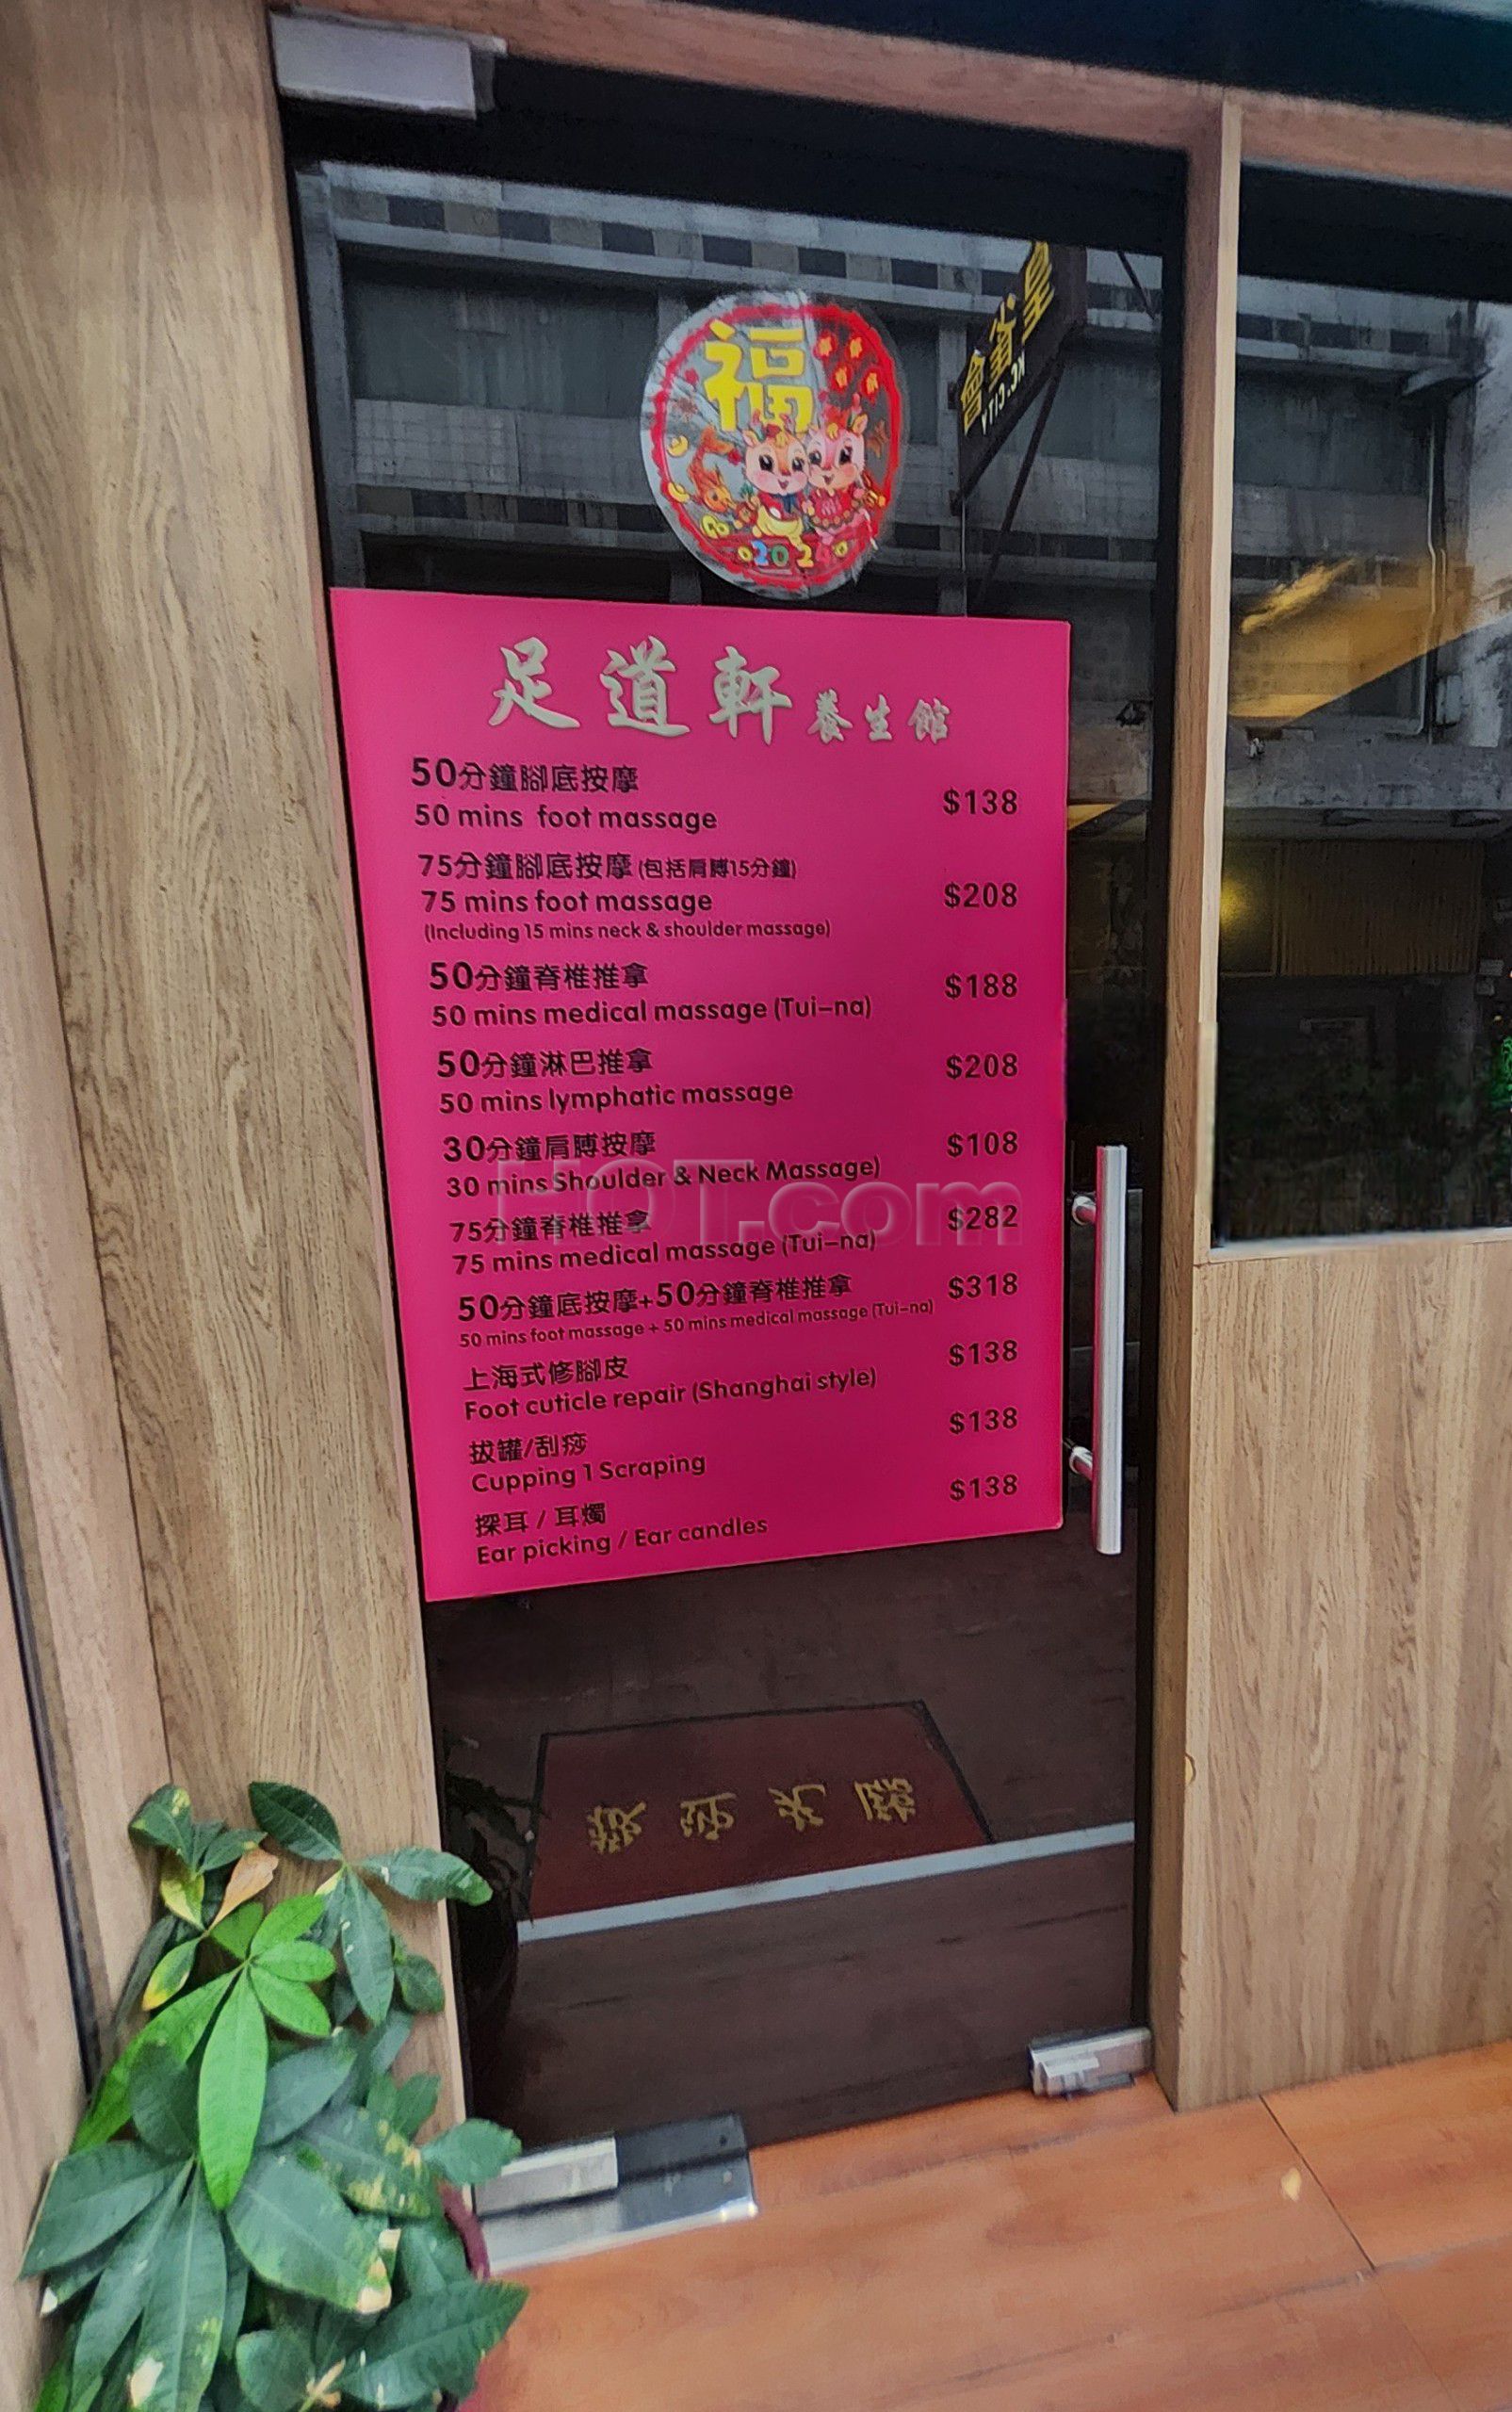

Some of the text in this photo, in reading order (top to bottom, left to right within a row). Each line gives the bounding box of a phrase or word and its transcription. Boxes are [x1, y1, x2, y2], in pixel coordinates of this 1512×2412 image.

[703, 318, 814, 433] 福
[489, 636, 951, 745] 足道軒 養生館
[412, 757, 639, 792] 50分鐘腳底按摩
[943, 790, 1017, 815] $138
[415, 804, 717, 834] 50 mins foot massage
[418, 852, 632, 880] 75分鐘腳底按摩
[422, 890, 712, 916] 75 mins foot massage
[944, 881, 1017, 908] $208
[425, 920, 831, 942] (Including 15 mins neck & shoulder massage)
[429, 961, 649, 992] 50分鐘脊椎推拿
[945, 973, 1017, 1000] $188
[431, 1005, 465, 1027] 50
[474, 1003, 537, 1026] mins
[545, 1000, 646, 1025] medical
[658, 1001, 767, 1024] massage
[437, 1047, 654, 1079] 50分鐘淋巴推拿
[945, 1052, 1017, 1080] $208
[439, 1083, 794, 1116] 50 mins lymphatic massage
[947, 1131, 1018, 1158] $108
[447, 1156, 881, 1198] 30 mins Shoulder & Neck Massage)
[947, 1204, 1018, 1231] $282
[452, 1253, 485, 1276] 75
[493, 1248, 553, 1272] mins
[559, 1241, 658, 1268] medical
[666, 1235, 775, 1263] massage
[948, 1272, 1018, 1300] $318
[460, 1333, 481, 1348] 50
[486, 1329, 527, 1346] mins
[530, 1327, 564, 1343] foot
[568, 1323, 644, 1339] massage
[649, 1324, 658, 1334] +
[663, 1317, 685, 1333] 50
[689, 1315, 726, 1332] mins
[730, 1309, 794, 1328] medical
[798, 1304, 869, 1323] massage
[949, 1339, 1018, 1367] $138
[463, 1356, 629, 1392] 上海式修腳皮
[464, 1367, 876, 1422] Foot cuticle repair (Shanghai style)
[949, 1407, 1018, 1435] $138
[471, 1466, 576, 1495] Cupping
[599, 1454, 707, 1479] Scraping
[950, 1474, 1018, 1502] $138
[536, 1509, 546, 1530] /
[476, 1517, 769, 1565] Ear picking / Ear candles
